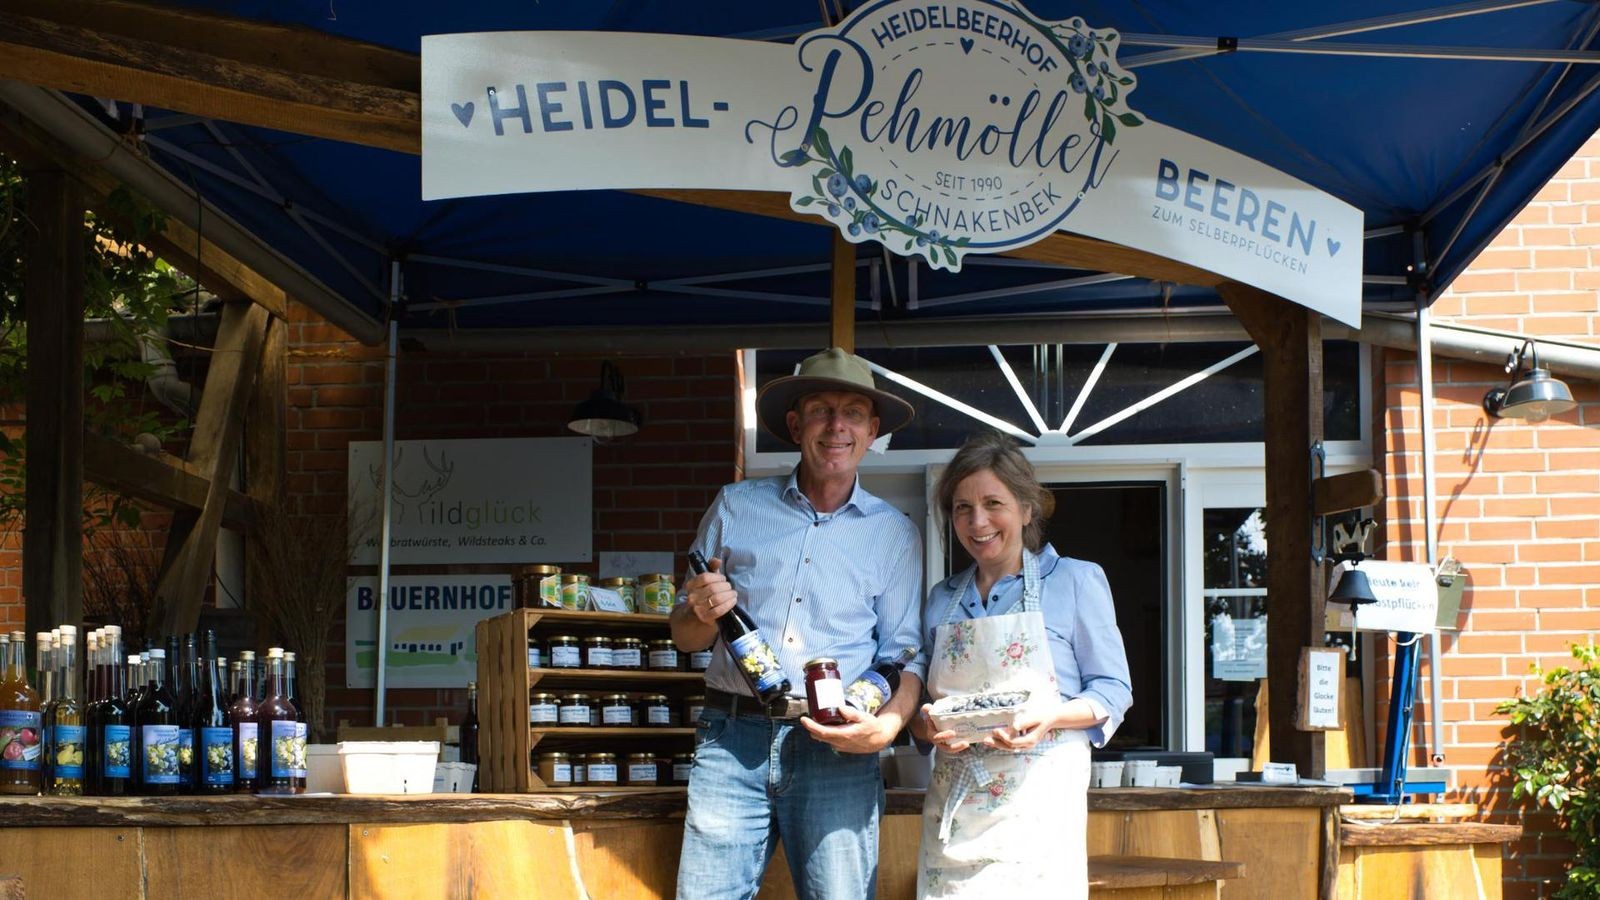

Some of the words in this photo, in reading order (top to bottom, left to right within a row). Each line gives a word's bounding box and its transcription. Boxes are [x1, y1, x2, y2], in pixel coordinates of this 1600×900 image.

[871, 6, 1058, 72] HEIDELBEERHOF
[486, 79, 730, 136] HEIDEL-
[746, 33, 1120, 190] Pehmöller
[880, 179, 1062, 233] SCHNAKENBEK
[935, 171, 966, 191] SEIT
[971, 176, 1003, 192] 1990
[1155, 158, 1316, 256] BEEREN
[1152, 205, 1183, 226] ZUM
[1188, 218, 1308, 275] SELBERPFLÜCKEN
[458, 535, 515, 547] Wildsteaks
[518, 535, 528, 546] &
[531, 535, 547, 546] Co.
[358, 584, 512, 611] BUERNHOF
